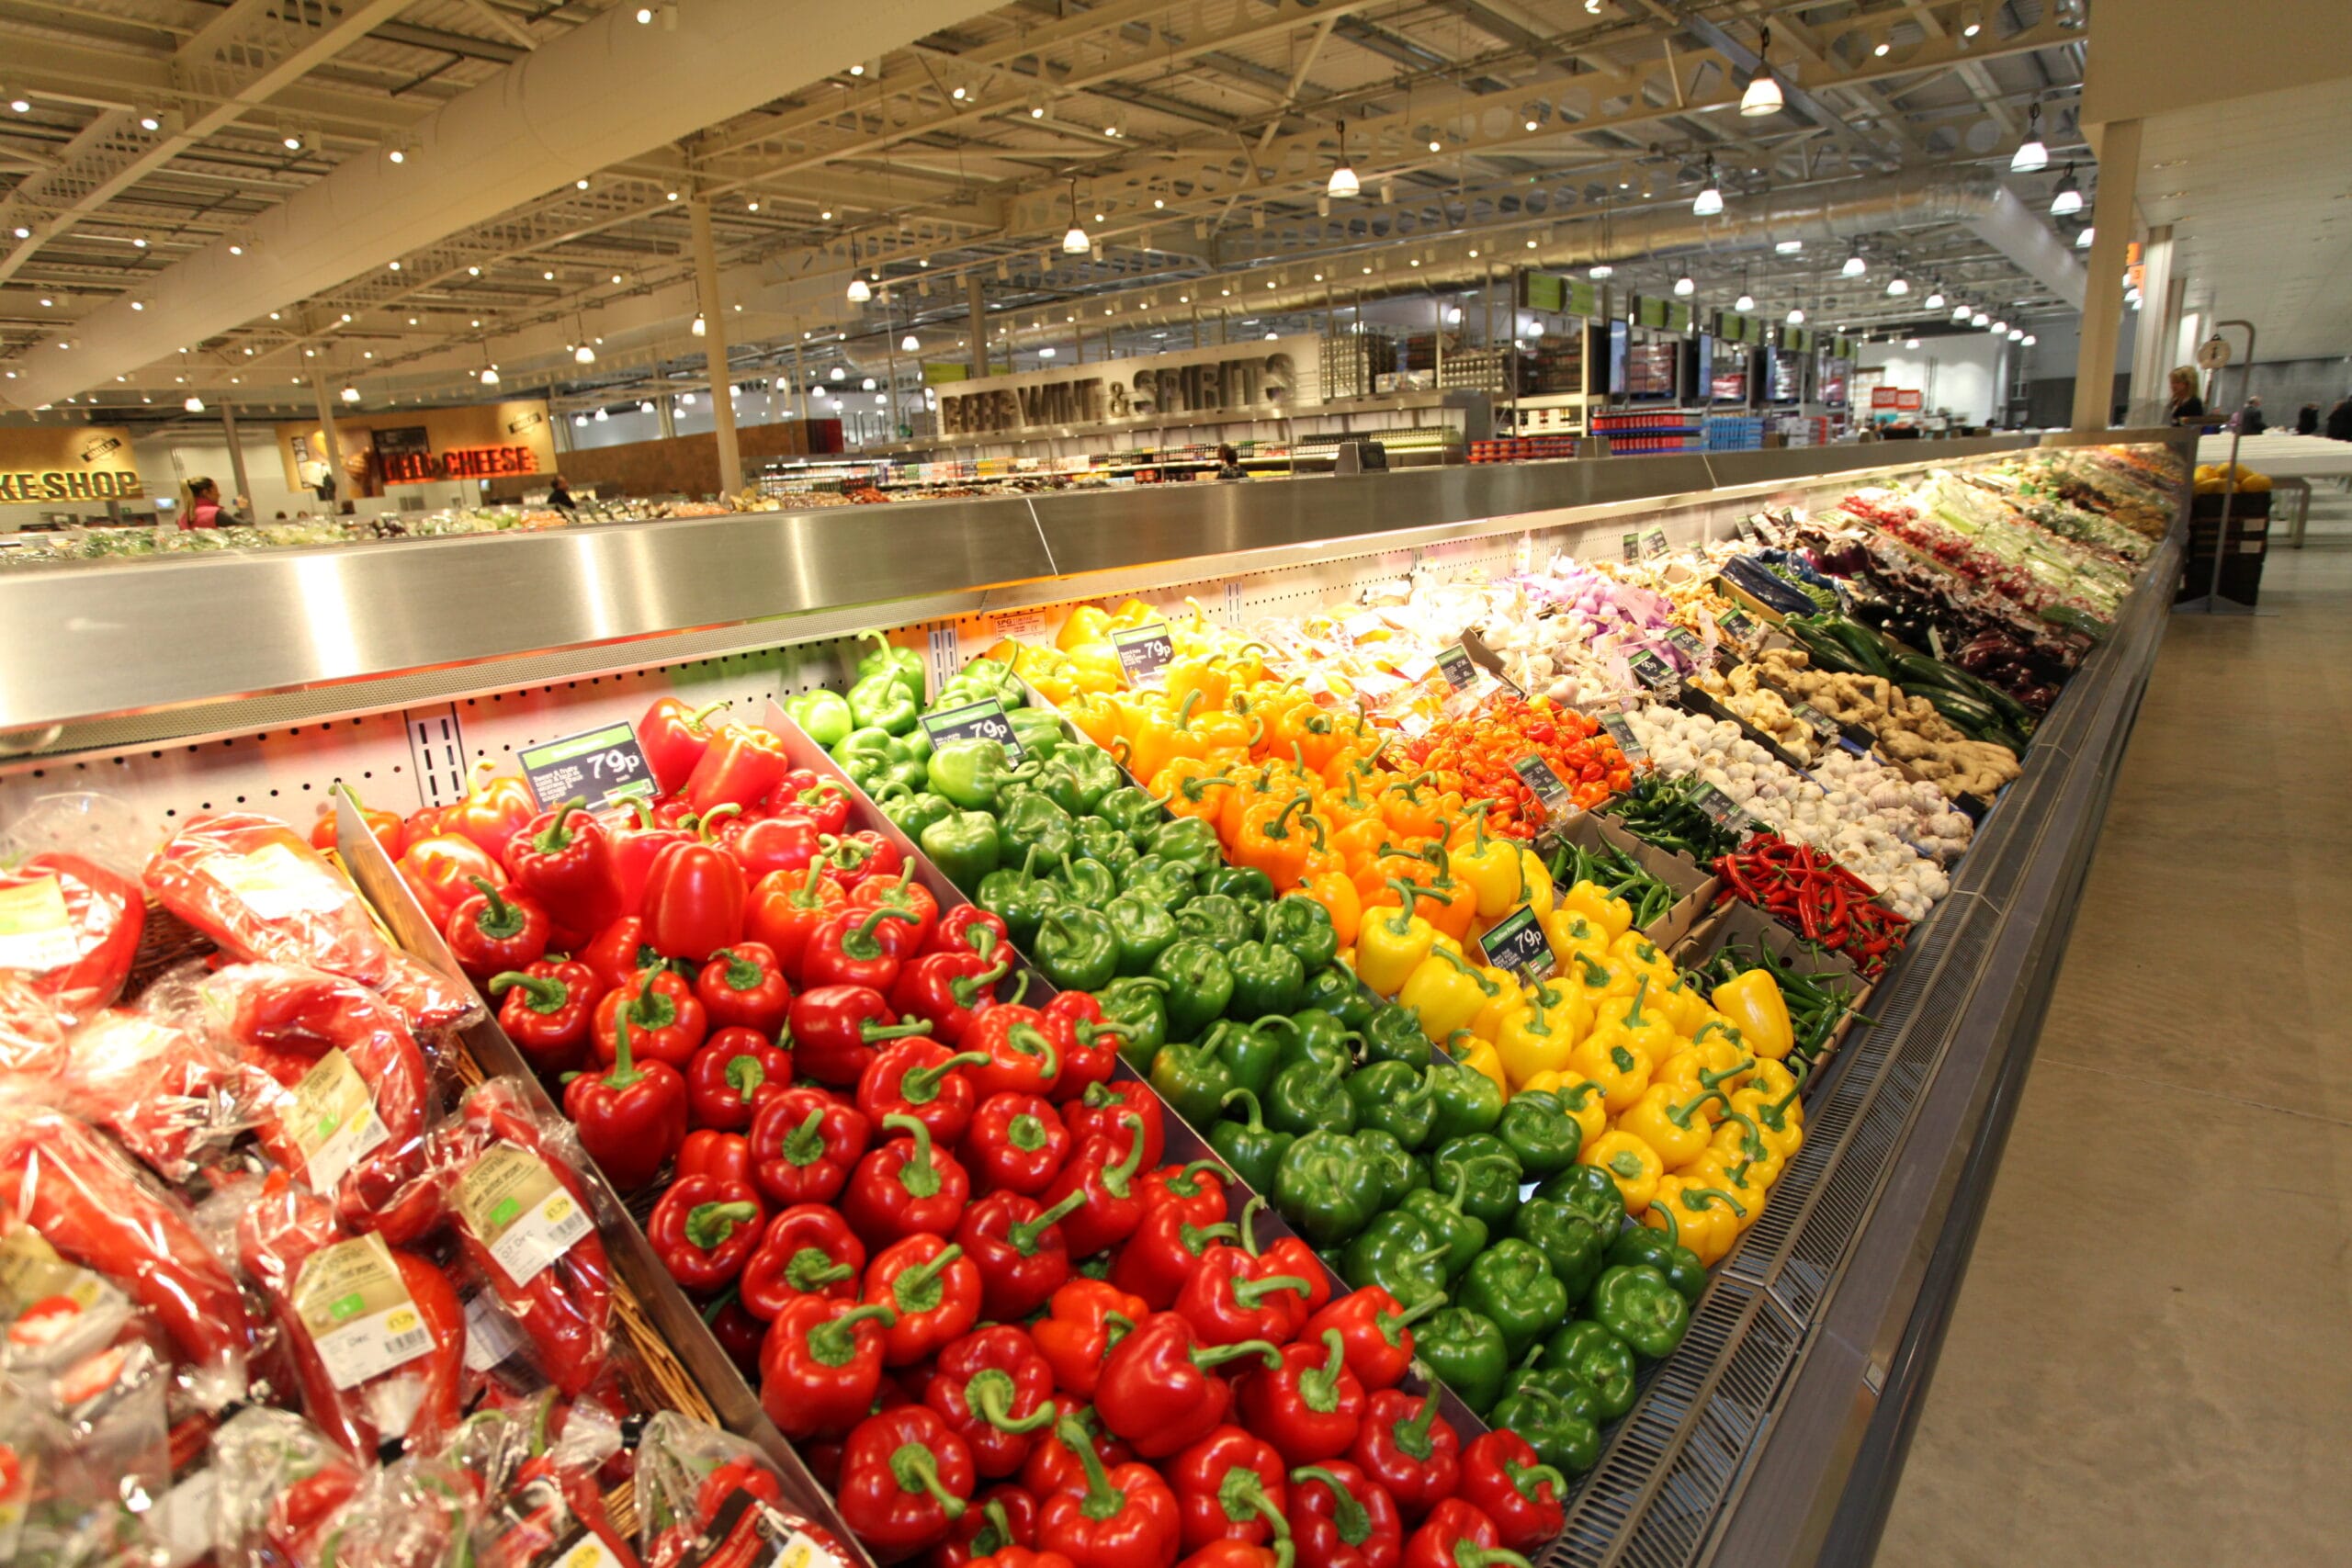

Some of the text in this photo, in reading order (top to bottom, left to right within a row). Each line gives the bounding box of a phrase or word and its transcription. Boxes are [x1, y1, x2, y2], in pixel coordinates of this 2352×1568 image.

[942, 353, 1295, 434] BEER WINE & SPIRITS
[442, 446, 532, 479] CHEESE
[42, 470, 138, 500] SHOP
[1144, 640, 1171, 659] 79p
[969, 719, 1008, 739] 79p
[586, 749, 640, 780] 79p
[1515, 928, 1542, 953] 79p
